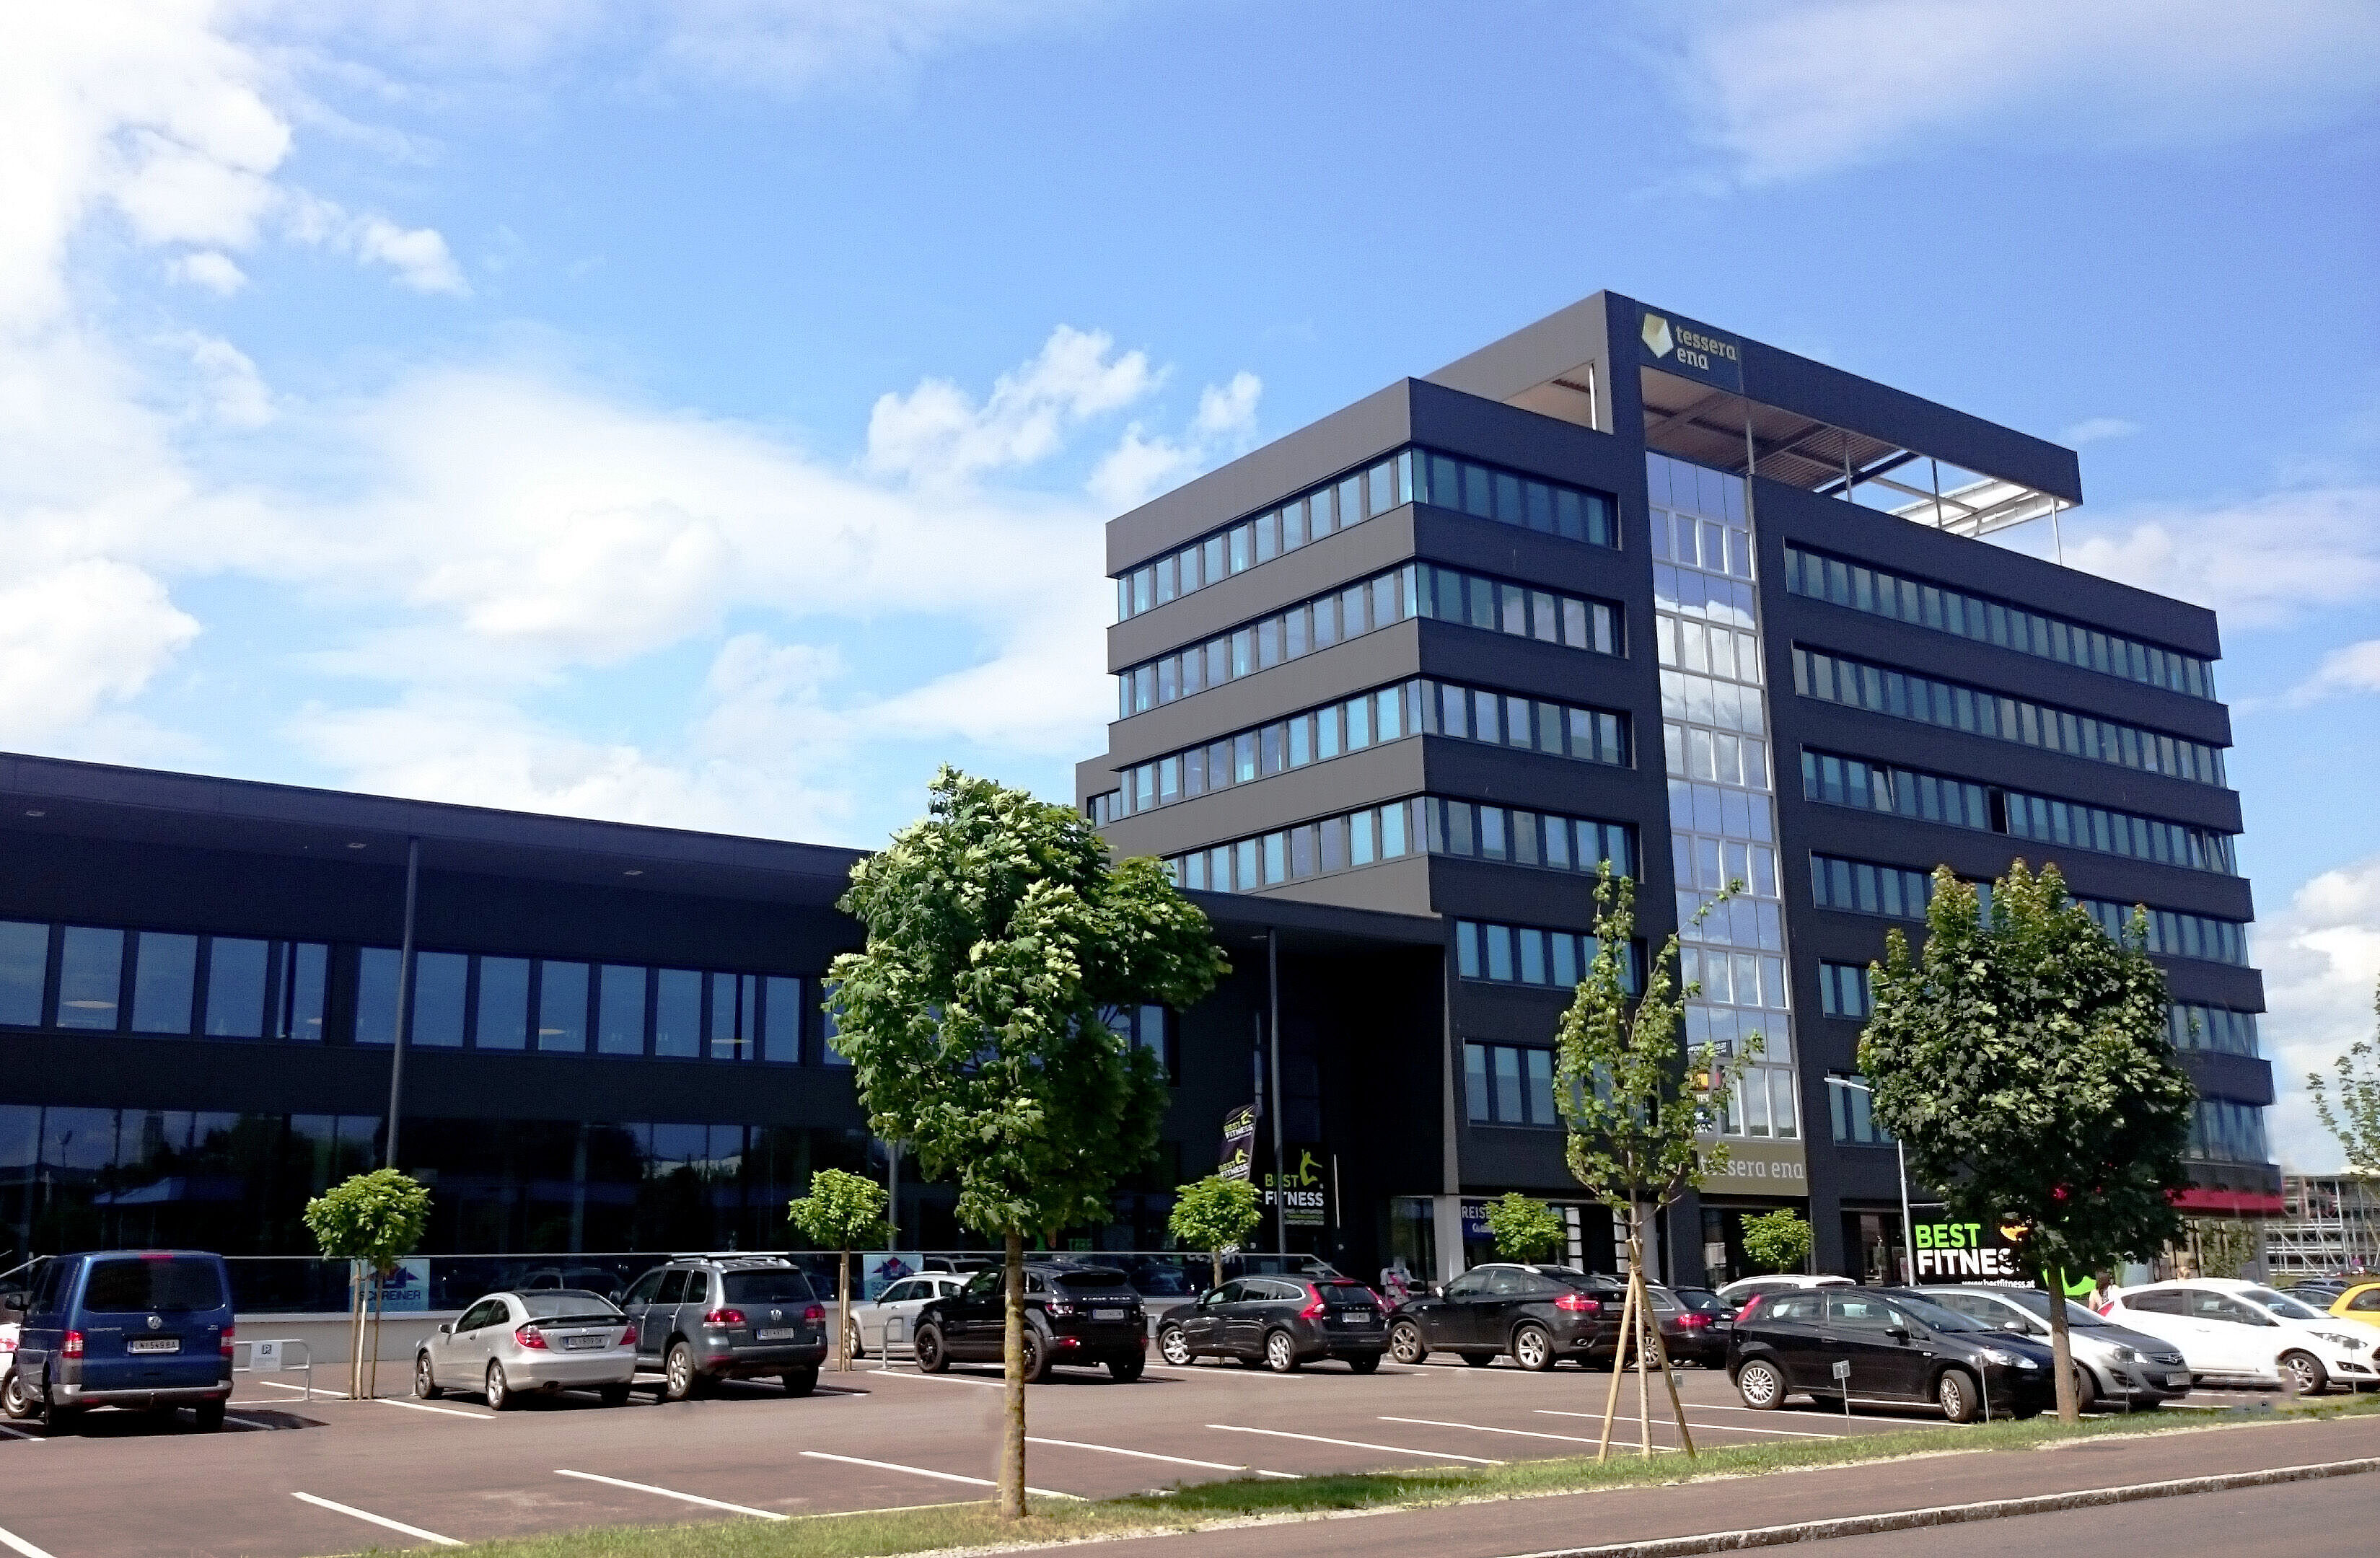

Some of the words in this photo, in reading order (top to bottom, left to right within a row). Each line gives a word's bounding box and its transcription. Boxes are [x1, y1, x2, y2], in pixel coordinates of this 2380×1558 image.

[1676, 325, 1736, 361] tessera
[1677, 348, 1709, 371] ena
[1225, 1123, 1254, 1140] FITNESS
[1699, 1156, 1766, 1177] tsera
[1771, 1162, 1804, 1179] ena
[1265, 1174, 1299, 1187] BST
[1915, 1223, 1981, 1249] BEST
[1917, 1248, 2021, 1275] FITNES
